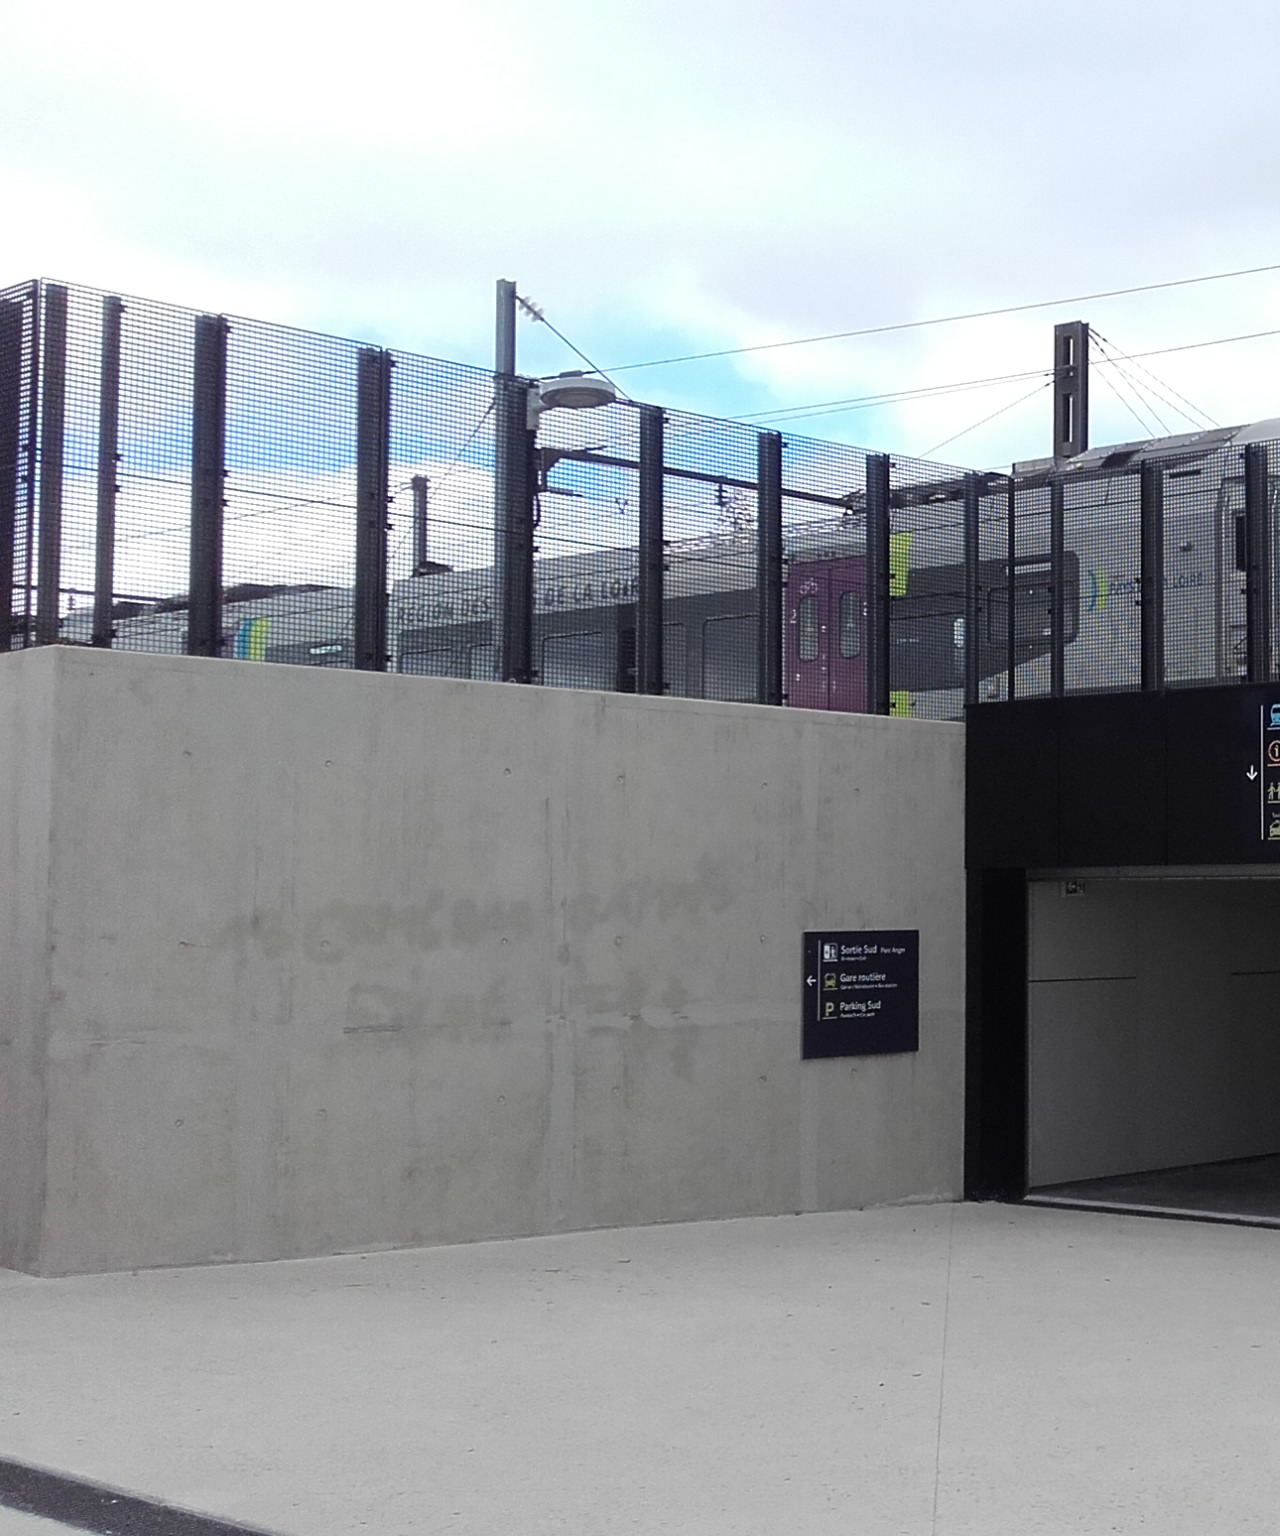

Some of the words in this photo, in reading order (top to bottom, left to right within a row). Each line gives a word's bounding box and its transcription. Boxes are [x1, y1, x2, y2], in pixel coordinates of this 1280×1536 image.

[841, 944, 863, 955] Sortie
[863, 943, 878, 954] Sud
[840, 972, 857, 982] Gare
[858, 971, 886, 982] routière
[825, 1002, 835, 1017] P
[839, 1001, 867, 1012] Parking
[867, 999, 881, 1010] Sud
